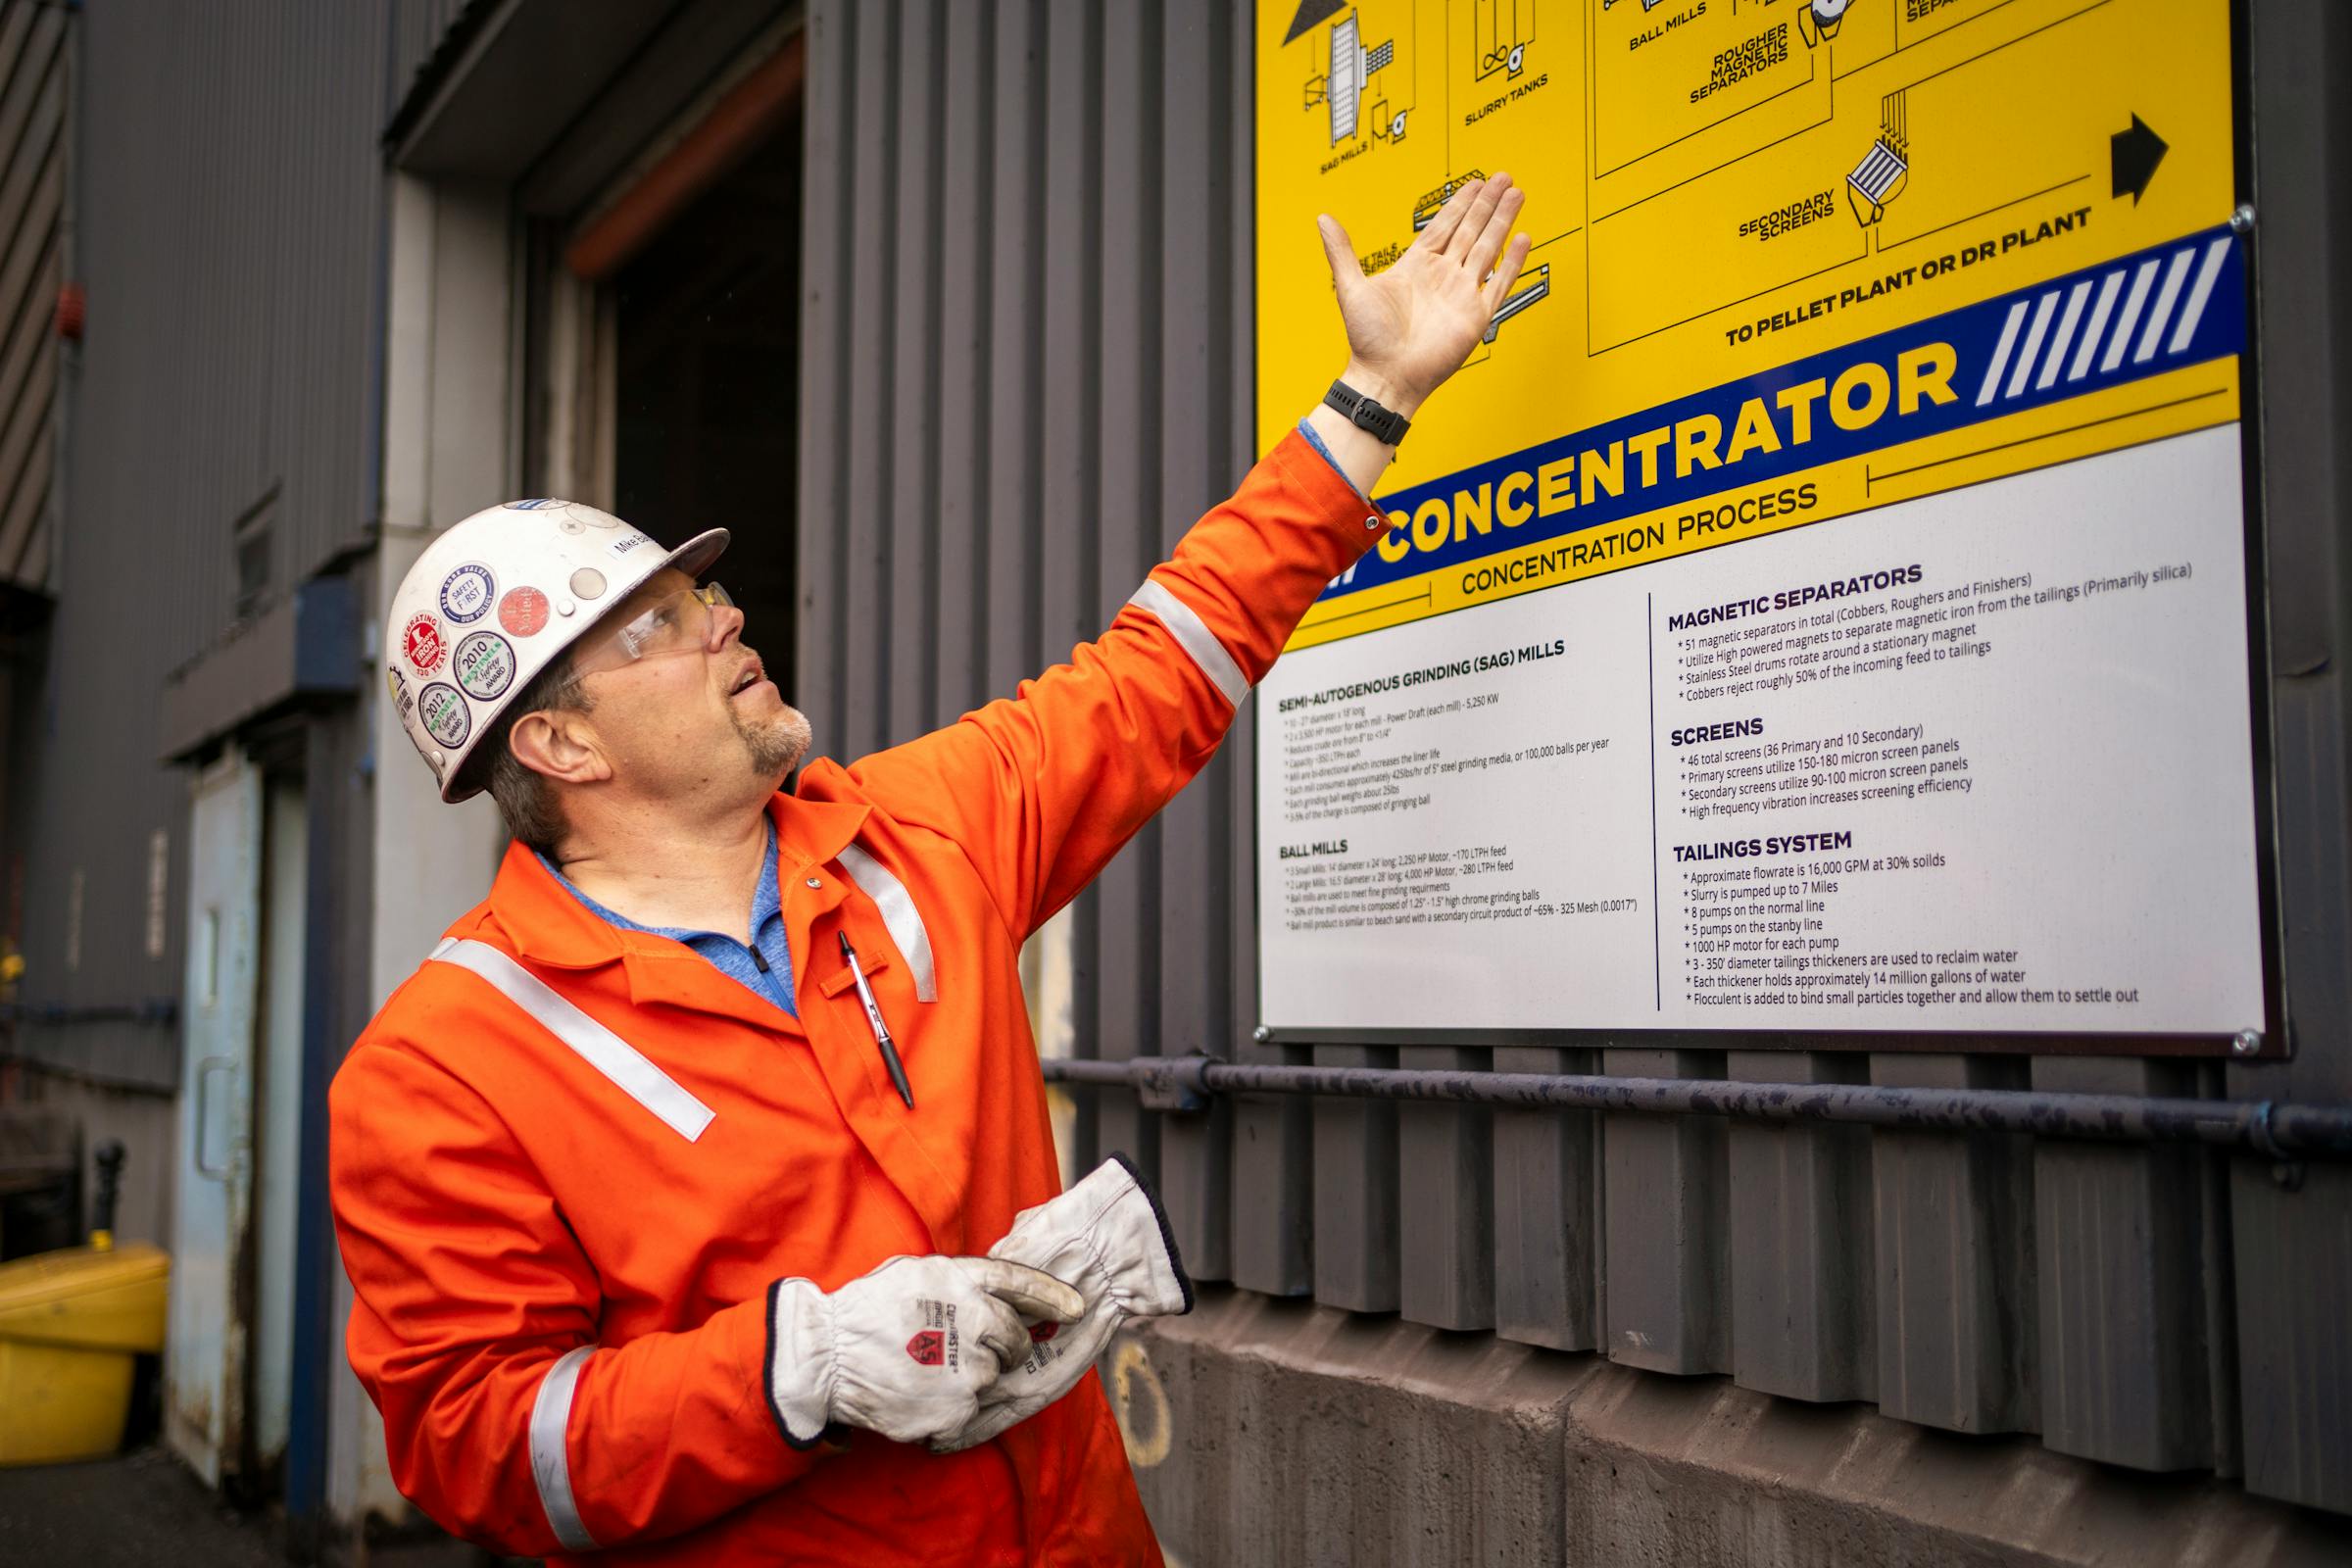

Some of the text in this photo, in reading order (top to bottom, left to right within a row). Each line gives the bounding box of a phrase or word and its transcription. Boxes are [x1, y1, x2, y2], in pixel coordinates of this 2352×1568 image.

[1629, 1, 1706, 51] BALL MILLS
[1711, 37, 1788, 81] MAGNETIC
[1714, 23, 1788, 68] ROUGHER
[1690, 49, 1788, 103] SEPARATORS
[1464, 73, 1548, 125] SLURRY TANKS
[1319, 140, 1368, 174] SAG MILLS
[1739, 188, 1835, 236] SECONDARY
[1760, 204, 1835, 241] SCREENS
[1725, 206, 2090, 346] TO PELLET PLANT OR DR PLANT
[1377, 342, 1959, 563] CONCENTRATOR
[613, 539, 639, 554] Mike
[1461, 482, 1818, 595] CONCENTRATION PROCESS
[452, 577, 475, 600] SAFETY
[1668, 564, 1922, 632] MAGNETIC SEPARATORS
[475, 594, 493, 617] POLICY
[1685, 571, 2032, 651] 51 magnetic separators in total (Cobbers, Roughers and Finishers)
[1686, 563, 2191, 667] Utilize High powered magnets to separate magnetic iron from the tailings (Primarily silica)
[403, 613, 437, 660] CELEBRATING
[416, 638, 436, 662] IRON
[419, 645, 439, 666] MINING
[431, 640, 447, 673] YEARS
[462, 641, 487, 670] 2010
[485, 666, 506, 690] AWARD
[1278, 639, 1564, 712] SEMI-AUTOGENOUS GRINDING (SAG) MILLS
[426, 692, 446, 719] 2012
[1466, 693, 1498, 709] 5,250 KW
[448, 718, 463, 739] AWARD
[1670, 717, 1763, 746] SCREENS
[1688, 723, 1923, 765] 46 total screens (36 Primary and 10 Secondary)
[1440, 760, 1457, 772] steel
[1457, 757, 1487, 772] grinding
[1514, 752, 1523, 761] or
[1525, 745, 1554, 760] 100,000
[1555, 742, 1574, 755] balls
[1576, 741, 1589, 755] per
[1591, 738, 1609, 753] year
[1689, 778, 1972, 820] High frequency vibration increases screening efficiency
[1279, 839, 1348, 859] BALL MILLS
[1416, 853, 1427, 862] HP
[1470, 847, 1489, 858] LTPH
[1490, 846, 1506, 857] feed
[1673, 830, 1851, 861] TAILINGS SYSTEM
[1690, 869, 1751, 885] Approximate
[1753, 866, 1794, 878] flowrate
[1796, 865, 1805, 876] is
[1808, 860, 1841, 875] 16,000
[1844, 858, 1869, 872] GPM
[1872, 858, 1884, 870] at
[1886, 856, 1910, 869] 30%
[1433, 909, 1468, 923] secondary
[1469, 908, 1492, 919] circuit
[1493, 906, 1522, 920] product
[1523, 904, 1532, 916] of
[1560, 902, 1575, 914] 325
[1576, 901, 1598, 912] Mesh
[1445, 889, 1540, 908] high chrome grinding balls
[1691, 917, 1823, 938] 5 pumps on the stanby line
[1693, 987, 2138, 1006] Flocculent is added to bind small particles together and allow them to settle out
